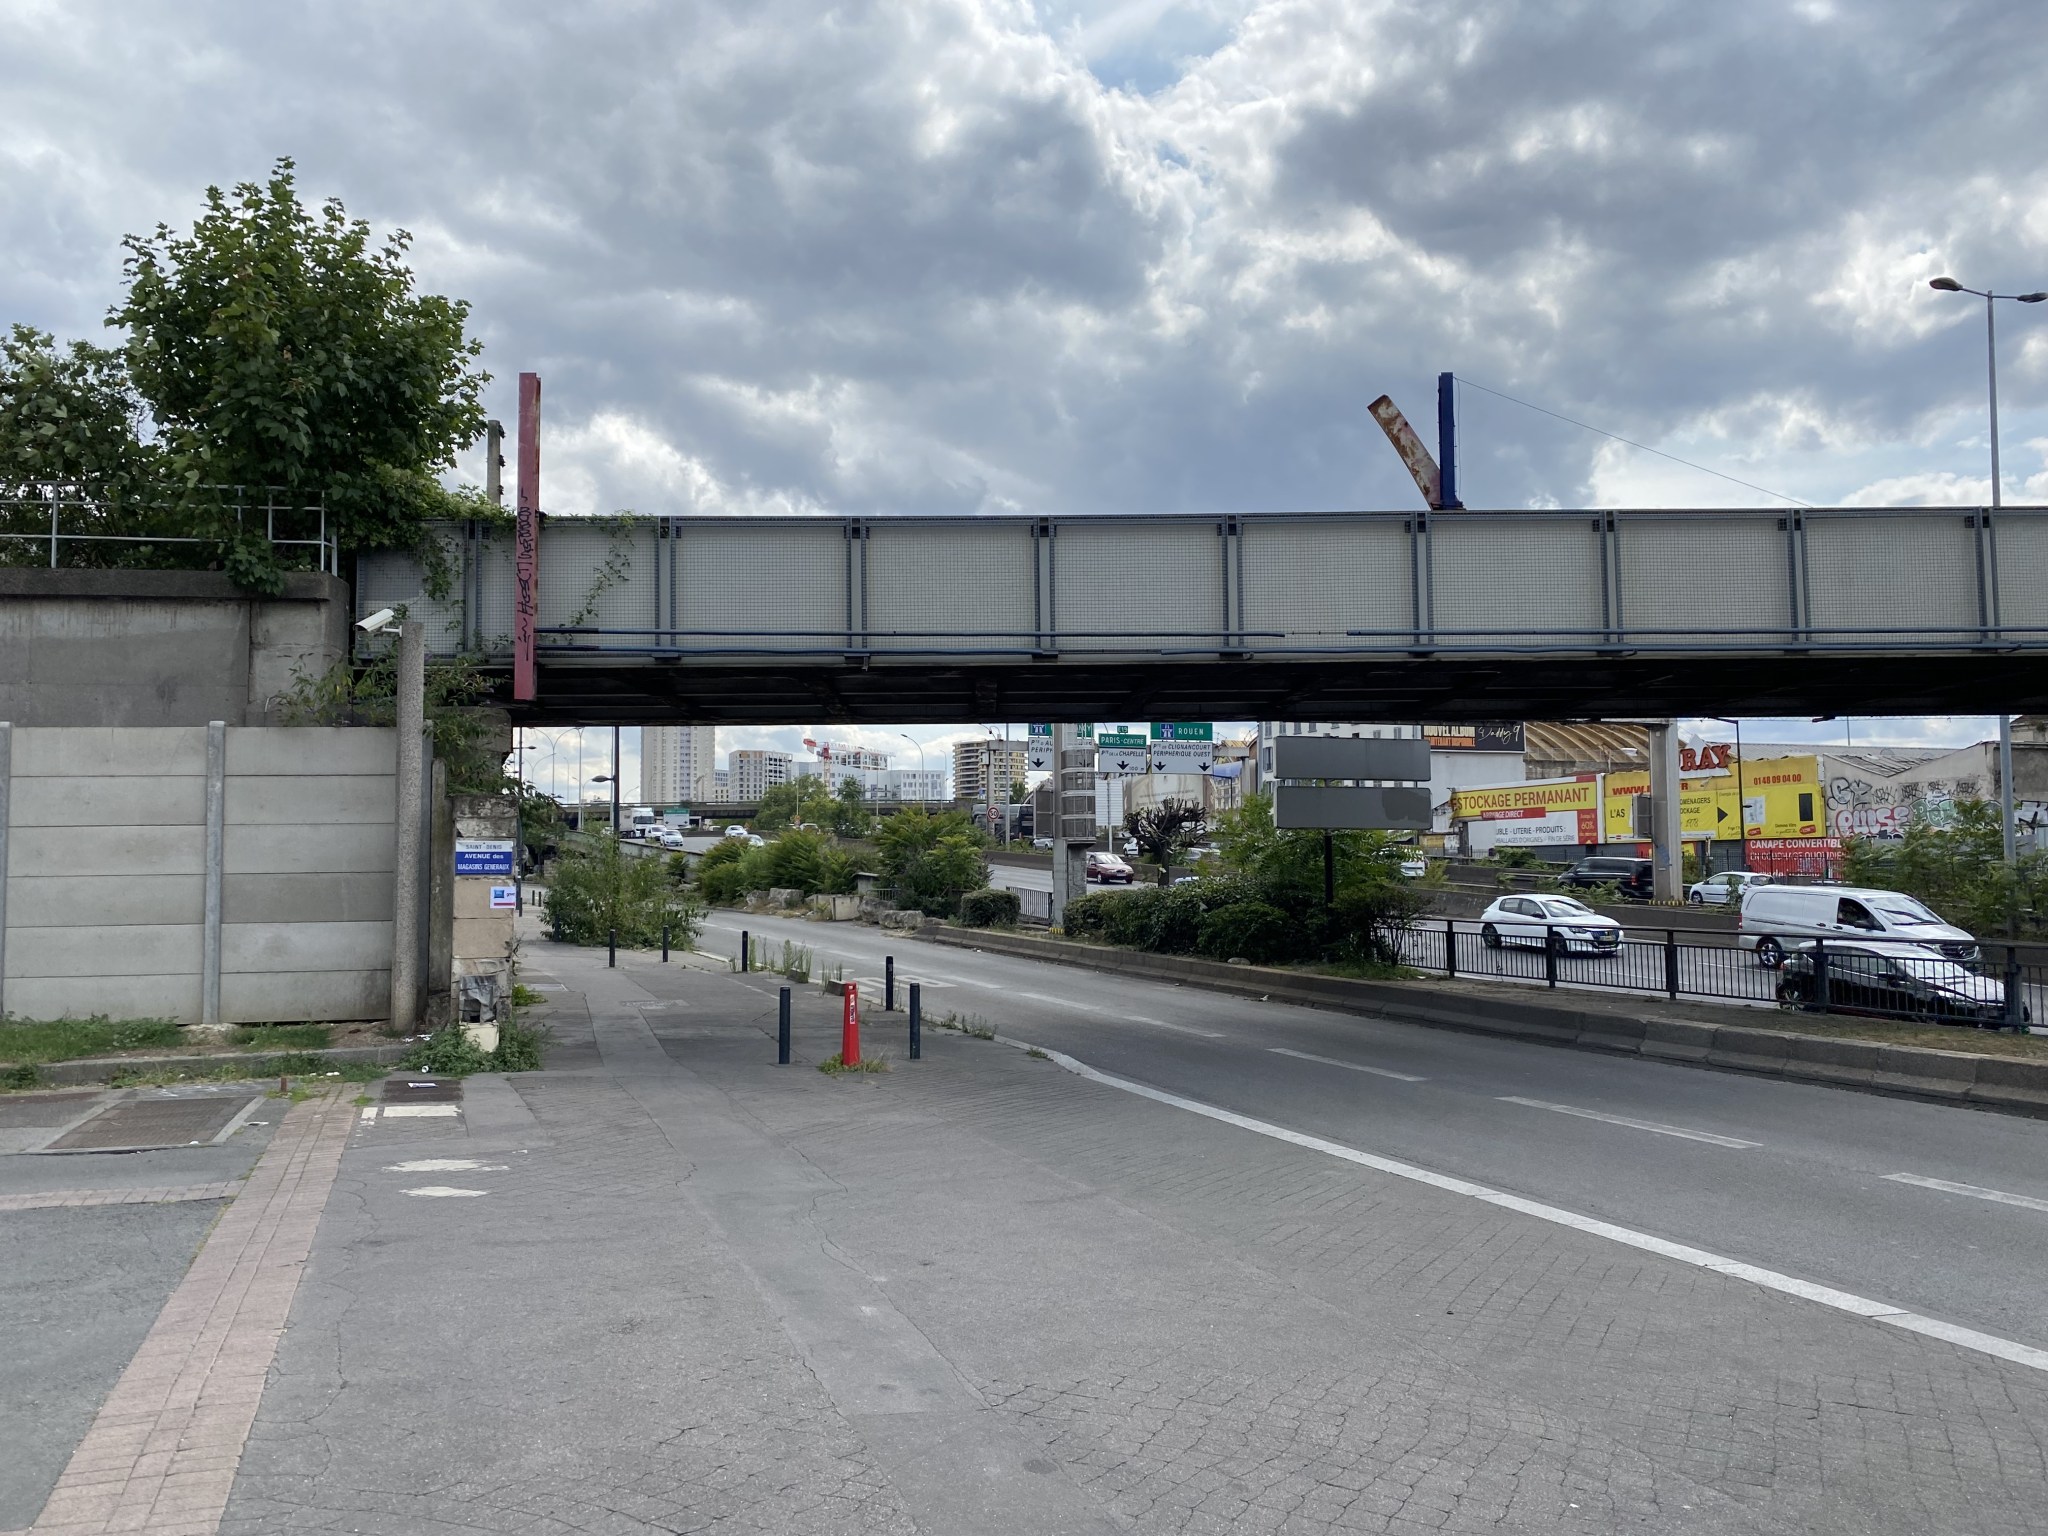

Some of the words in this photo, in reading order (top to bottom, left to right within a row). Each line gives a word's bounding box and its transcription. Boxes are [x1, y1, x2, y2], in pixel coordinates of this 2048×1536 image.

[1178, 727, 1204, 735] ROUEN
[1753, 777, 1761, 785] 01
[1782, 774, 1791, 783] 04
[1792, 773, 1802, 782] 00
[1514, 787, 1589, 807] PERMANANT
[1505, 810, 1524, 818] DIRECT
[1750, 840, 1784, 849] CANAPE
[1785, 839, 1842, 848] CONVERTIBL
